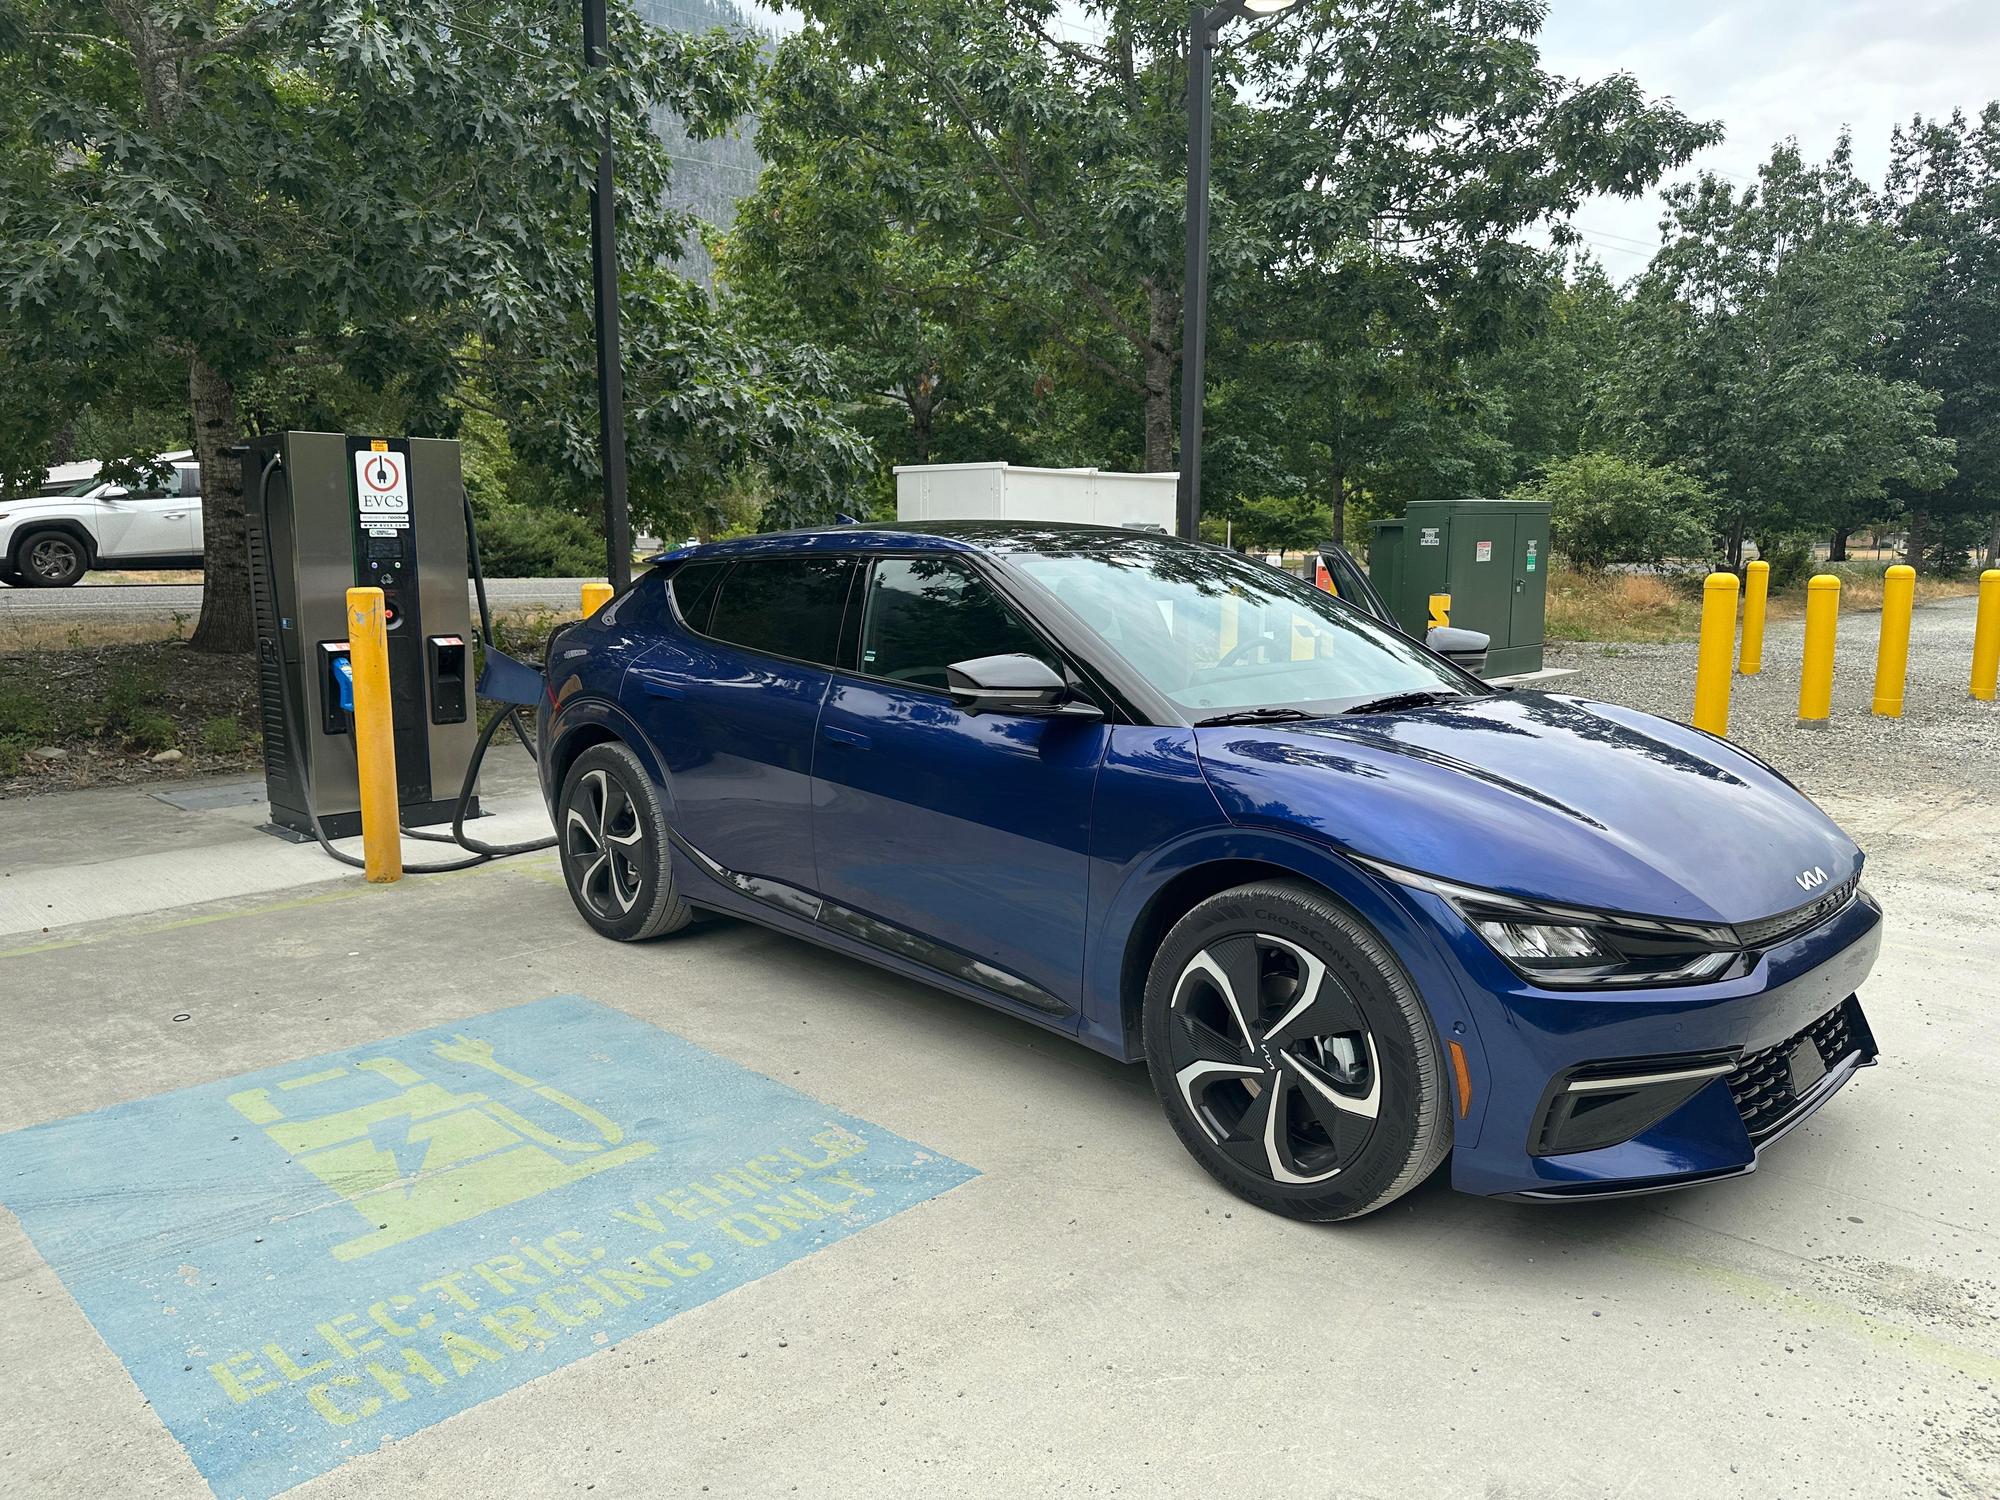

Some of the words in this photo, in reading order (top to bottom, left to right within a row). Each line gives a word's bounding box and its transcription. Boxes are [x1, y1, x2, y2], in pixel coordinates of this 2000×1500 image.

[364, 495, 404, 508] EVCS
[1795, 866, 1828, 891] KIA
[207, 1230, 606, 1404] ELECTRIC
[612, 1131, 868, 1233] VEHICLE
[306, 1240, 715, 1425] CHARGING
[719, 1168, 877, 1247] ONLY
